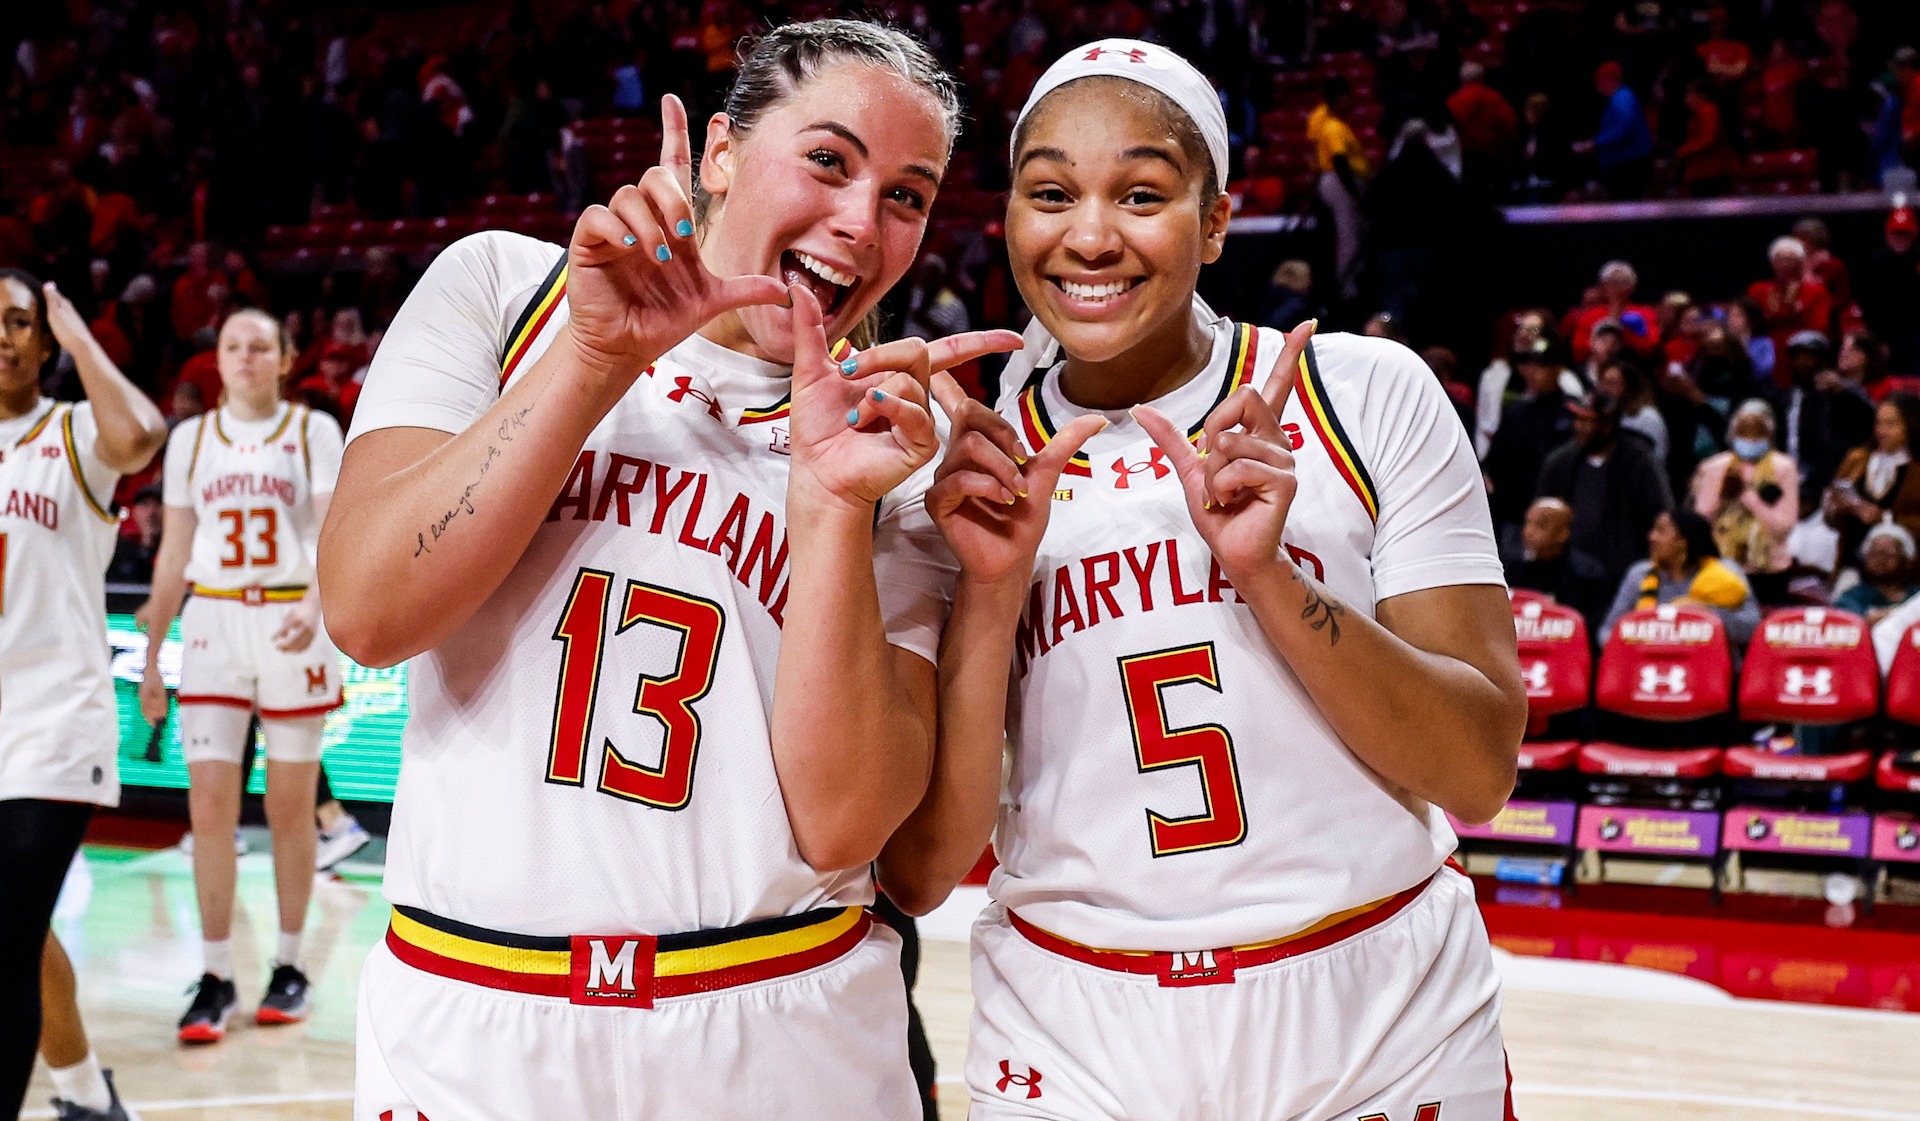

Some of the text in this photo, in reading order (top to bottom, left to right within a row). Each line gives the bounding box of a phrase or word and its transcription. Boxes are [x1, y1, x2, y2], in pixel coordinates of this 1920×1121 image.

[203, 471, 296, 508] MARYLAND
[218, 508, 278, 569] 33
[545, 450, 789, 631] ARYLAN
[1620, 618, 1715, 644] MARYLAND
[1764, 622, 1862, 648] MARYLAND
[304, 663, 328, 694] M
[545, 567, 726, 812] 13
[1117, 641, 1248, 858] 5
[585, 938, 640, 991] M
